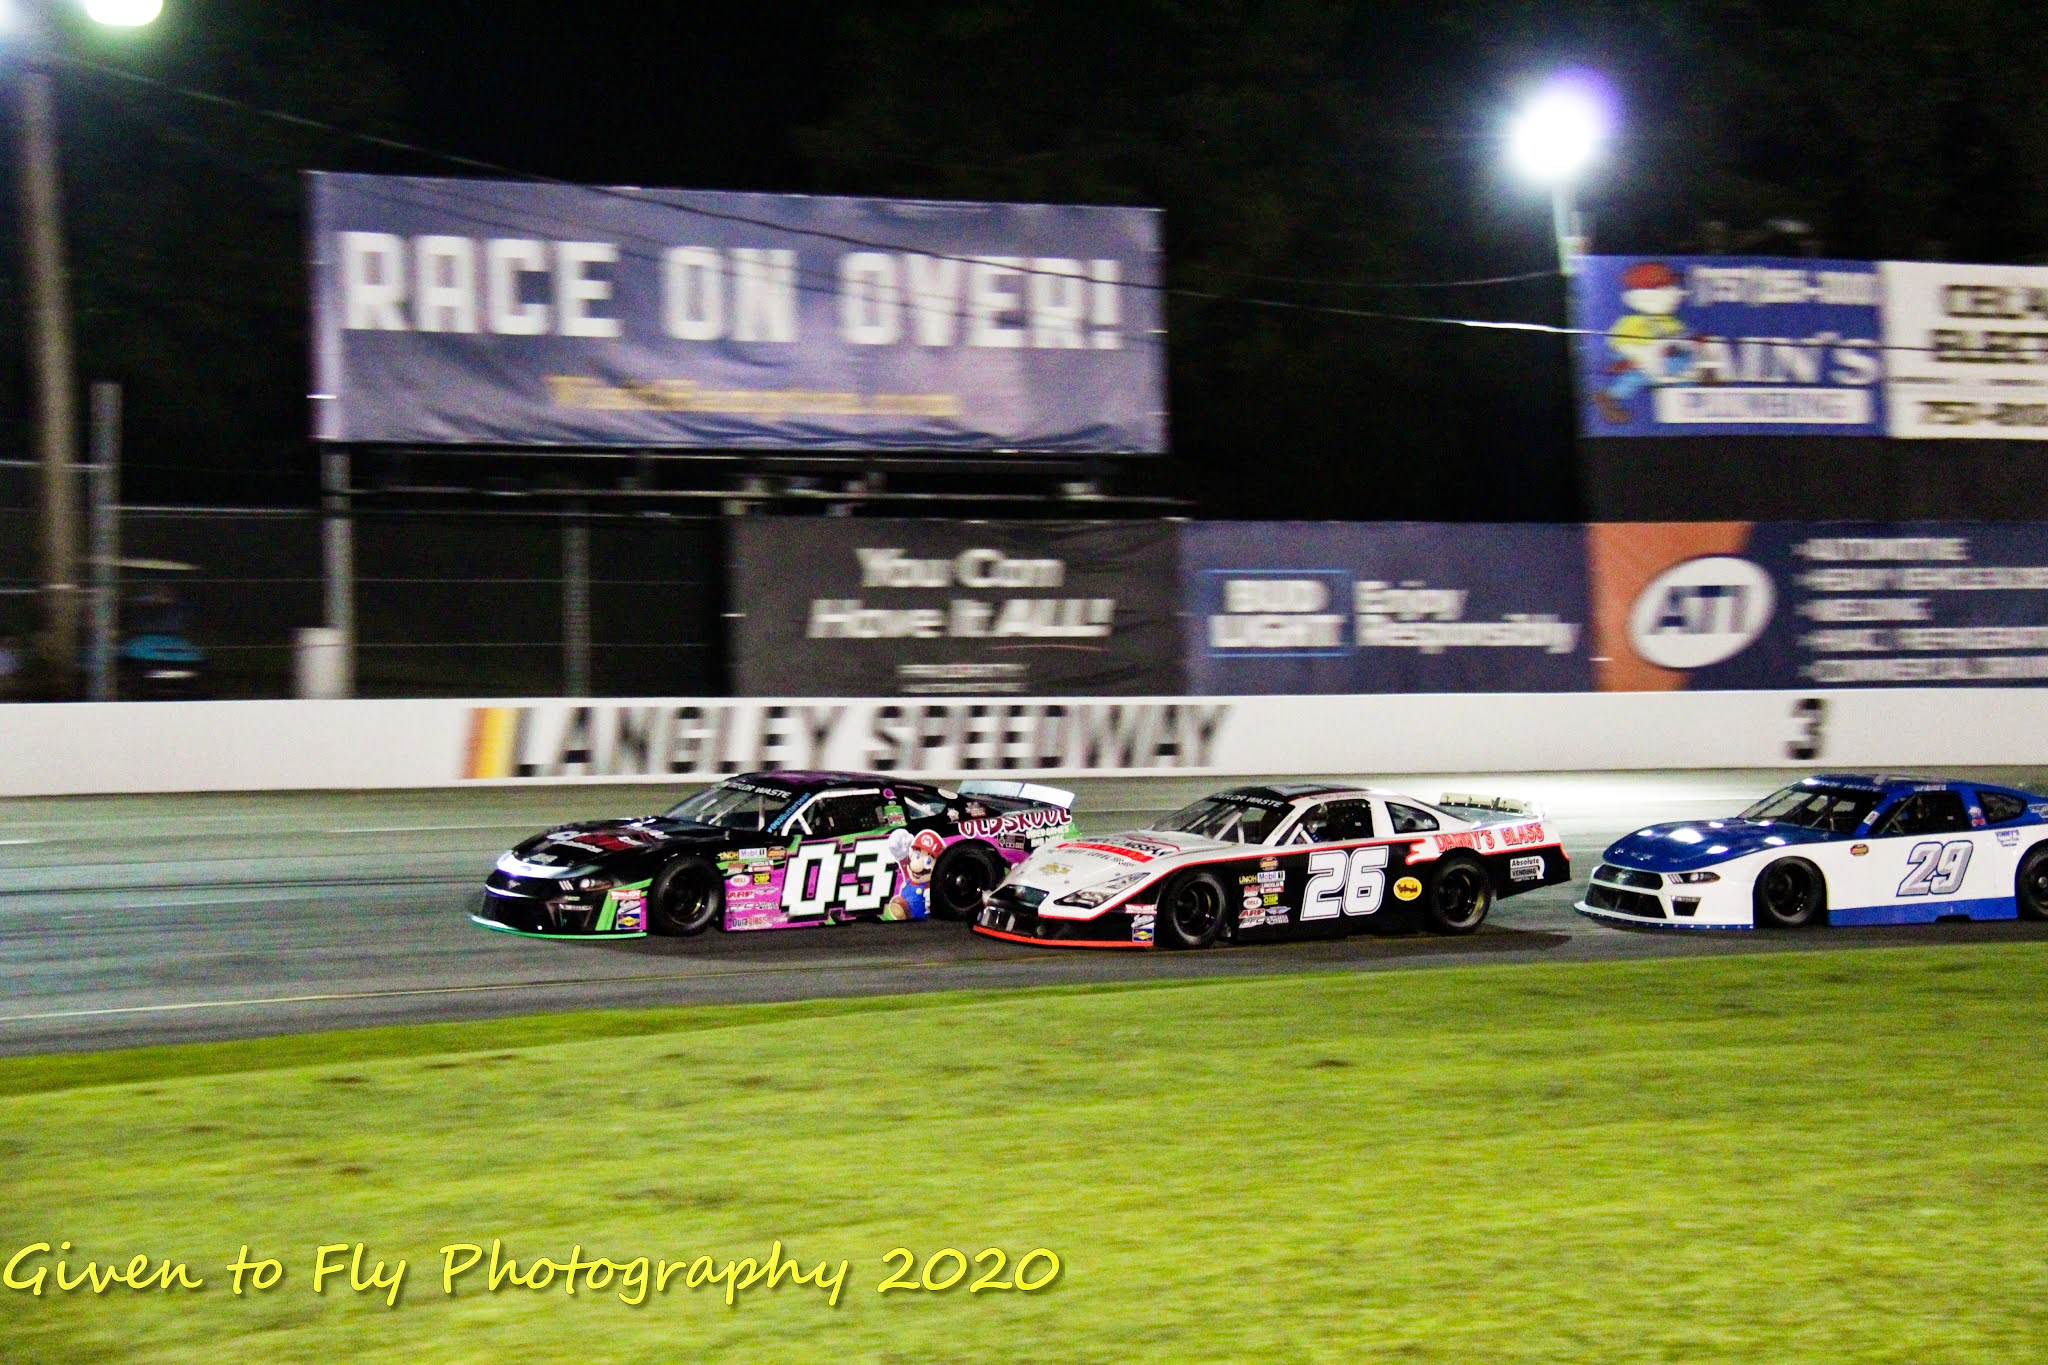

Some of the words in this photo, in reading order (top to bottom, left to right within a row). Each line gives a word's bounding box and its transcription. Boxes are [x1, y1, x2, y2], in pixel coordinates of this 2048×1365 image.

[339, 231, 621, 337] RACE
[665, 245, 797, 343] ON
[840, 251, 1122, 349] OVER!
[856, 547, 953, 588] You
[511, 704, 846, 776] LANGLEY
[868, 703, 1232, 770] SPEEDWAY
[1788, 698, 1828, 761] 3
[754, 786, 792, 799] WASTE
[1246, 796, 1285, 808] WASTE
[1434, 829, 1495, 853] DANNY'S
[1500, 822, 1546, 846] GLASS
[781, 838, 897, 917] 03
[1259, 872, 1277, 880] Mobil
[1511, 858, 1540, 867] Absolute
[1897, 840, 1974, 897] 29
[728, 891, 754, 899] ARP
[1300, 845, 1389, 921] 26
[1240, 909, 1264, 917] ARP
